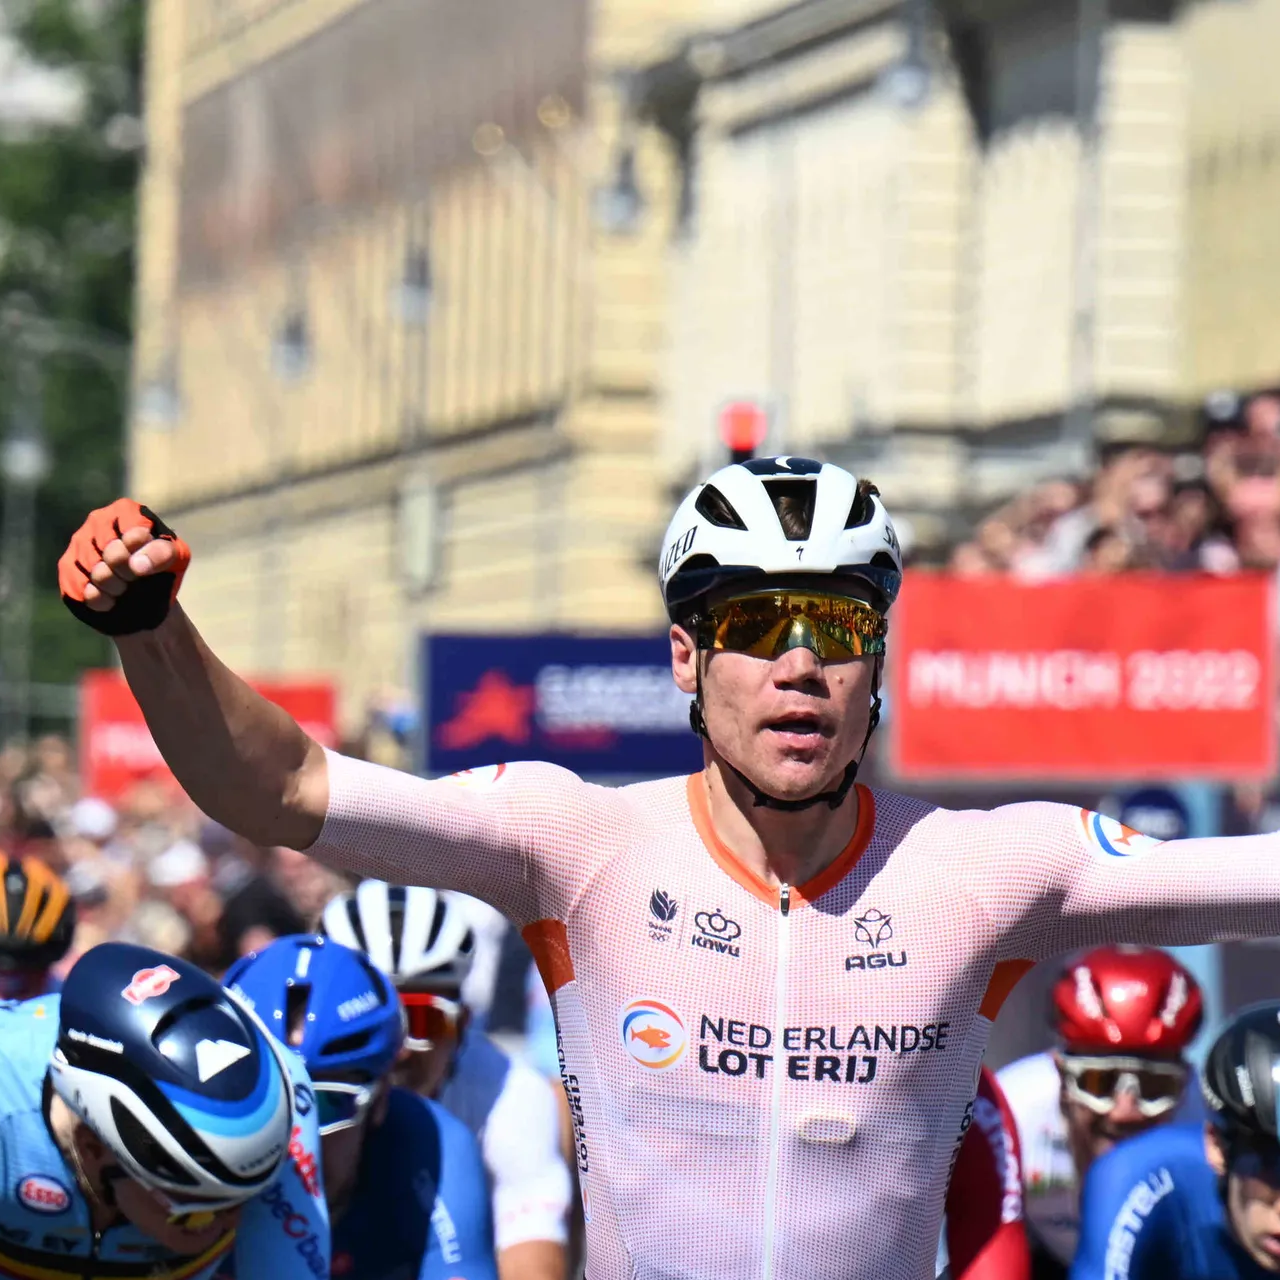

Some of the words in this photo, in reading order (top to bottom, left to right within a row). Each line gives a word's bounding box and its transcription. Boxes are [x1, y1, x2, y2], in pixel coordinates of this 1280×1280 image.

[845, 951, 908, 971] AGU
[699, 1014, 950, 1053] NEDERLANDSE
[699, 1044, 878, 1084] LOTERIJ
